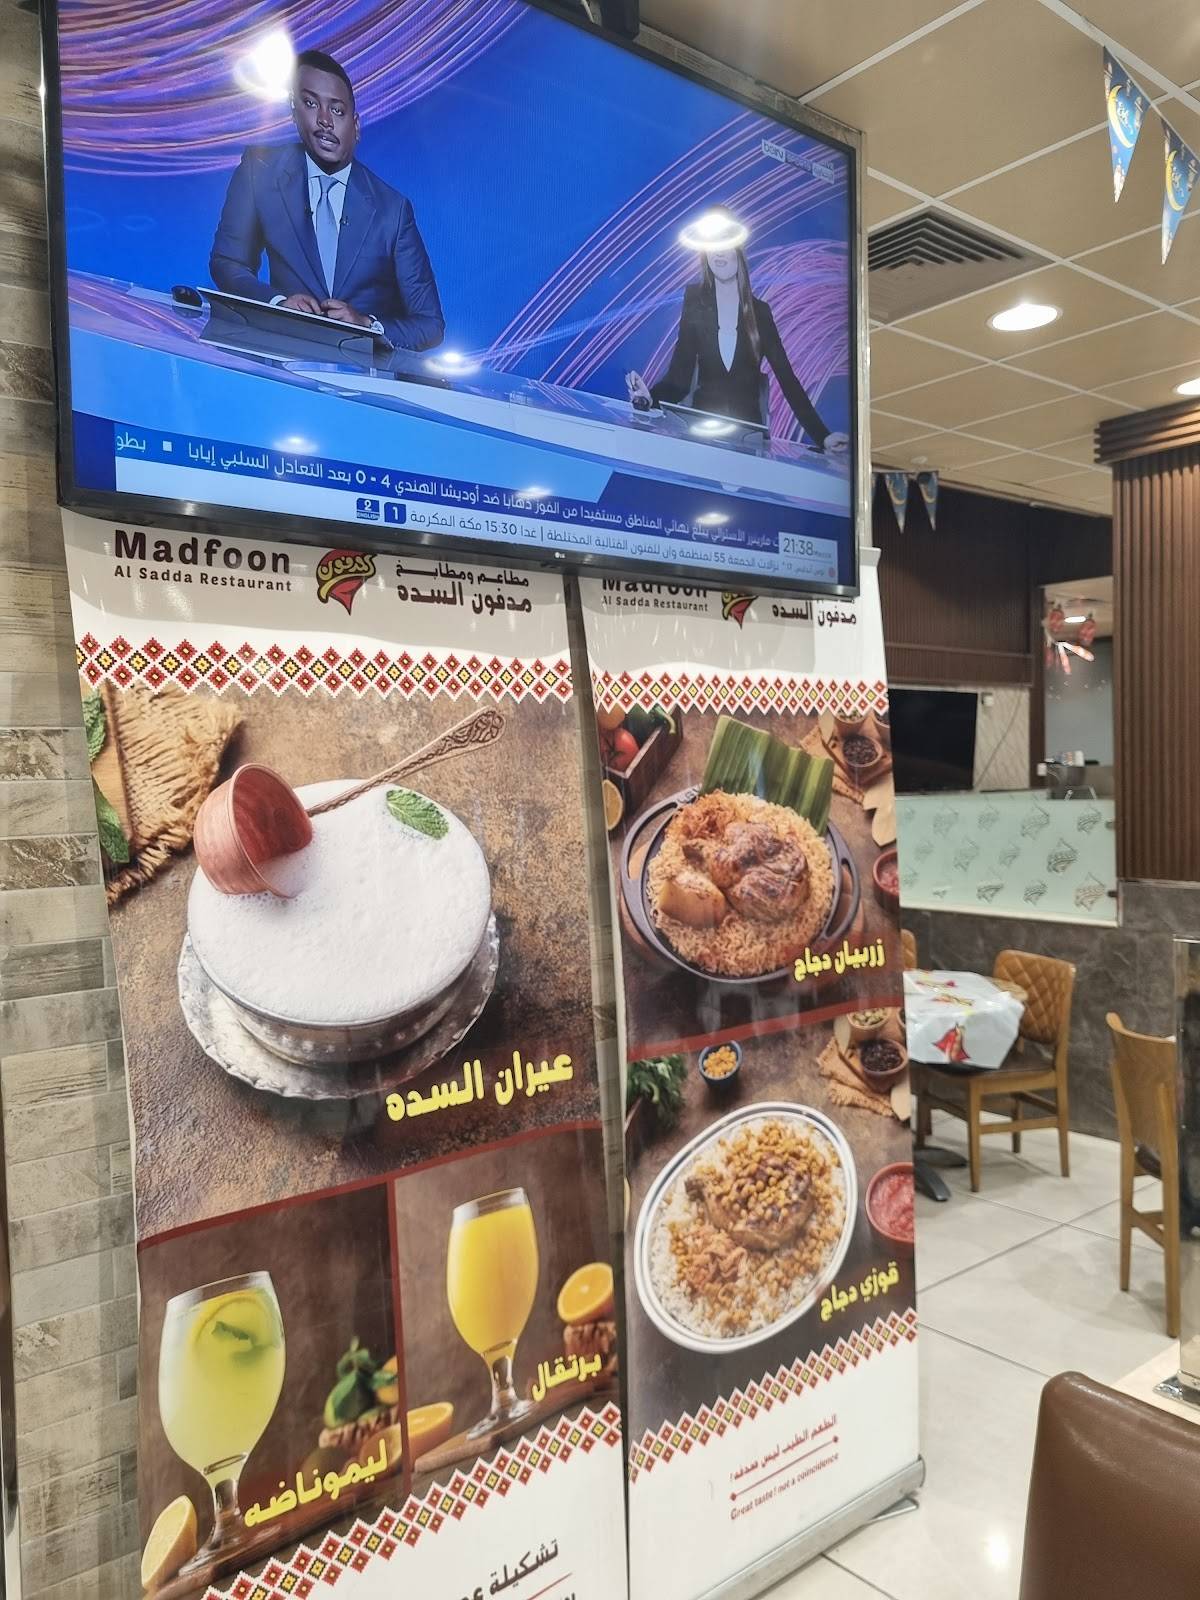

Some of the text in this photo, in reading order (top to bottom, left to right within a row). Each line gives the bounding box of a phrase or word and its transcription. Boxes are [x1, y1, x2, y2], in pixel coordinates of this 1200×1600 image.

[188, 442, 217, 467] إيابا
[220, 450, 269, 470] السلبي
[274, 457, 323, 479] التعادل
[327, 469, 352, 485] بعد
[355, 470, 367, 485] 0
[381, 474, 391, 488] 4
[394, 480, 437, 497] الهندي
[441, 483, 480, 505] أوديشا
[483, 492, 500, 505] ضد
[534, 499, 560, 516] الفوز
[562, 507, 578, 519] من
[580, 505, 622, 524] مستفيدا
[410, 511, 456, 528] المكرمة
[459, 516, 482, 531] مكة
[625, 513, 662, 530] المناطق
[520, 524, 537, 539] غدا
[546, 526, 592, 546] المختلطة
[115, 529, 290, 574] Madfoon
[783, 537, 814, 556] 21:38
[713, 551, 726, 564] 55
[114, 565, 292, 592] Al Sadda Restaurant
[477, 570, 530, 587] مطاعم
[397, 581, 532, 616] مدفون السده
[602, 595, 708, 612] Al Sadda Restaurant
[772, 600, 813, 621] السده
[817, 605, 857, 628] مدفون
[794, 938, 886, 982] زربيان دجاج
[385, 1050, 574, 1121] عيران السده
[820, 1260, 900, 1322] قوزي دجاج
[531, 1353, 602, 1402] برتقال
[244, 1438, 389, 1528] ليموناضه
[730, 1501, 754, 1520] Great
[777, 1479, 791, 1493] not
[796, 1452, 840, 1484] coincidence
[489, 1538, 560, 1596] تشكيلة
